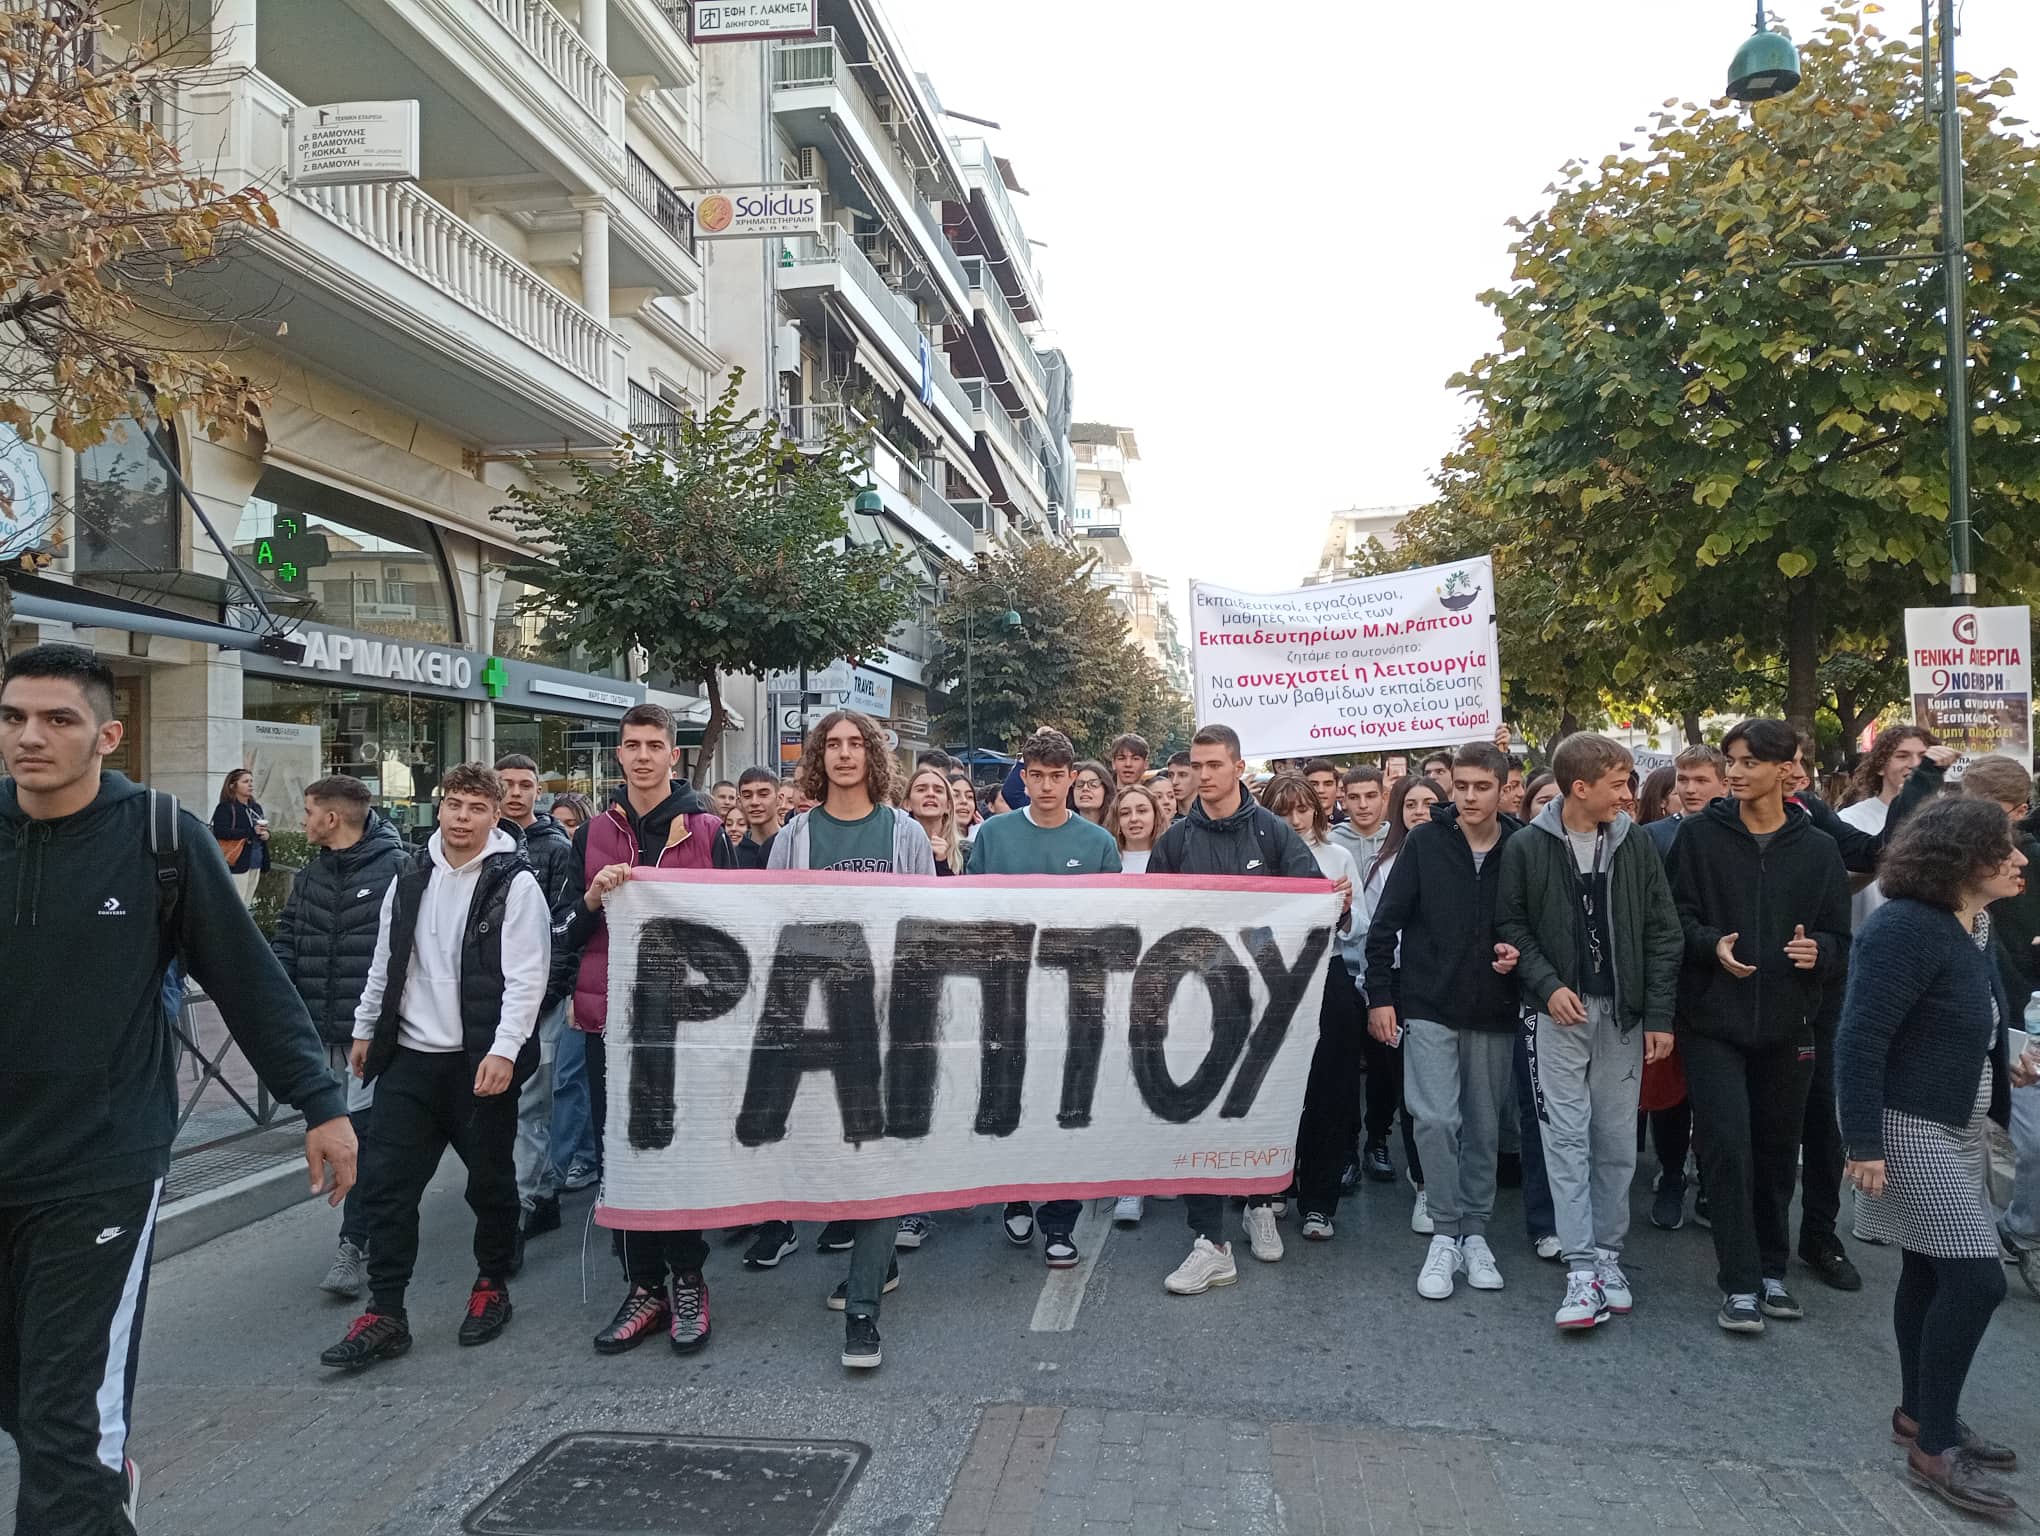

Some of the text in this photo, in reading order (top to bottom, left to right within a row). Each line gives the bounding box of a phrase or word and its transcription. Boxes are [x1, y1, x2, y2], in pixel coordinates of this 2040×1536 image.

[750, 6, 759, 15] Γ.
[761, 3, 808, 14] ΛΑΚΜΕΤΑ
[725, 18, 770, 28] ΔΙΚΗΓΟΡΟΣ
[312, 129, 365, 140] ΒΛΑΜΟΥΛΗΣ
[312, 138, 366, 149] ΒΛΑΜΟΥΛΗΣ
[312, 147, 347, 158] ΚΟΚΚΑΣ
[312, 160, 360, 171] ΒΛΑΜΟΥΛΗ
[736, 193, 814, 217] Solidus
[736, 217, 814, 226] ΧΡΗΜΑΤΙΣΤΗΡΙΑΚΗ
[1305, 590, 1403, 611] εργαζόμενοι,
[1222, 607, 1393, 627] μαθητές και γονείς των
[1200, 626, 1357, 646] Εκπαιδευτηρίων
[1287, 643, 1421, 664] ζητάμε το αυτονόητο:
[1914, 648, 1964, 667] ΓΕΝΙΚΗ
[1212, 650, 1486, 689] Να συνεχιστεί η λειτουργία
[854, 675, 874, 697] TRAVEL
[1212, 675, 1483, 708] όλων των βαθμίδων εκπαίδευσης
[1932, 669, 1950, 696] 9
[1338, 705, 1368, 718] του
[1373, 697, 1449, 718] σχολείου
[1928, 697, 1961, 711] Καμία
[1310, 709, 1489, 739] όπως ίσχυε έως τώρα!
[628, 917, 1332, 1150] ΡΑΠΤΟΥ
